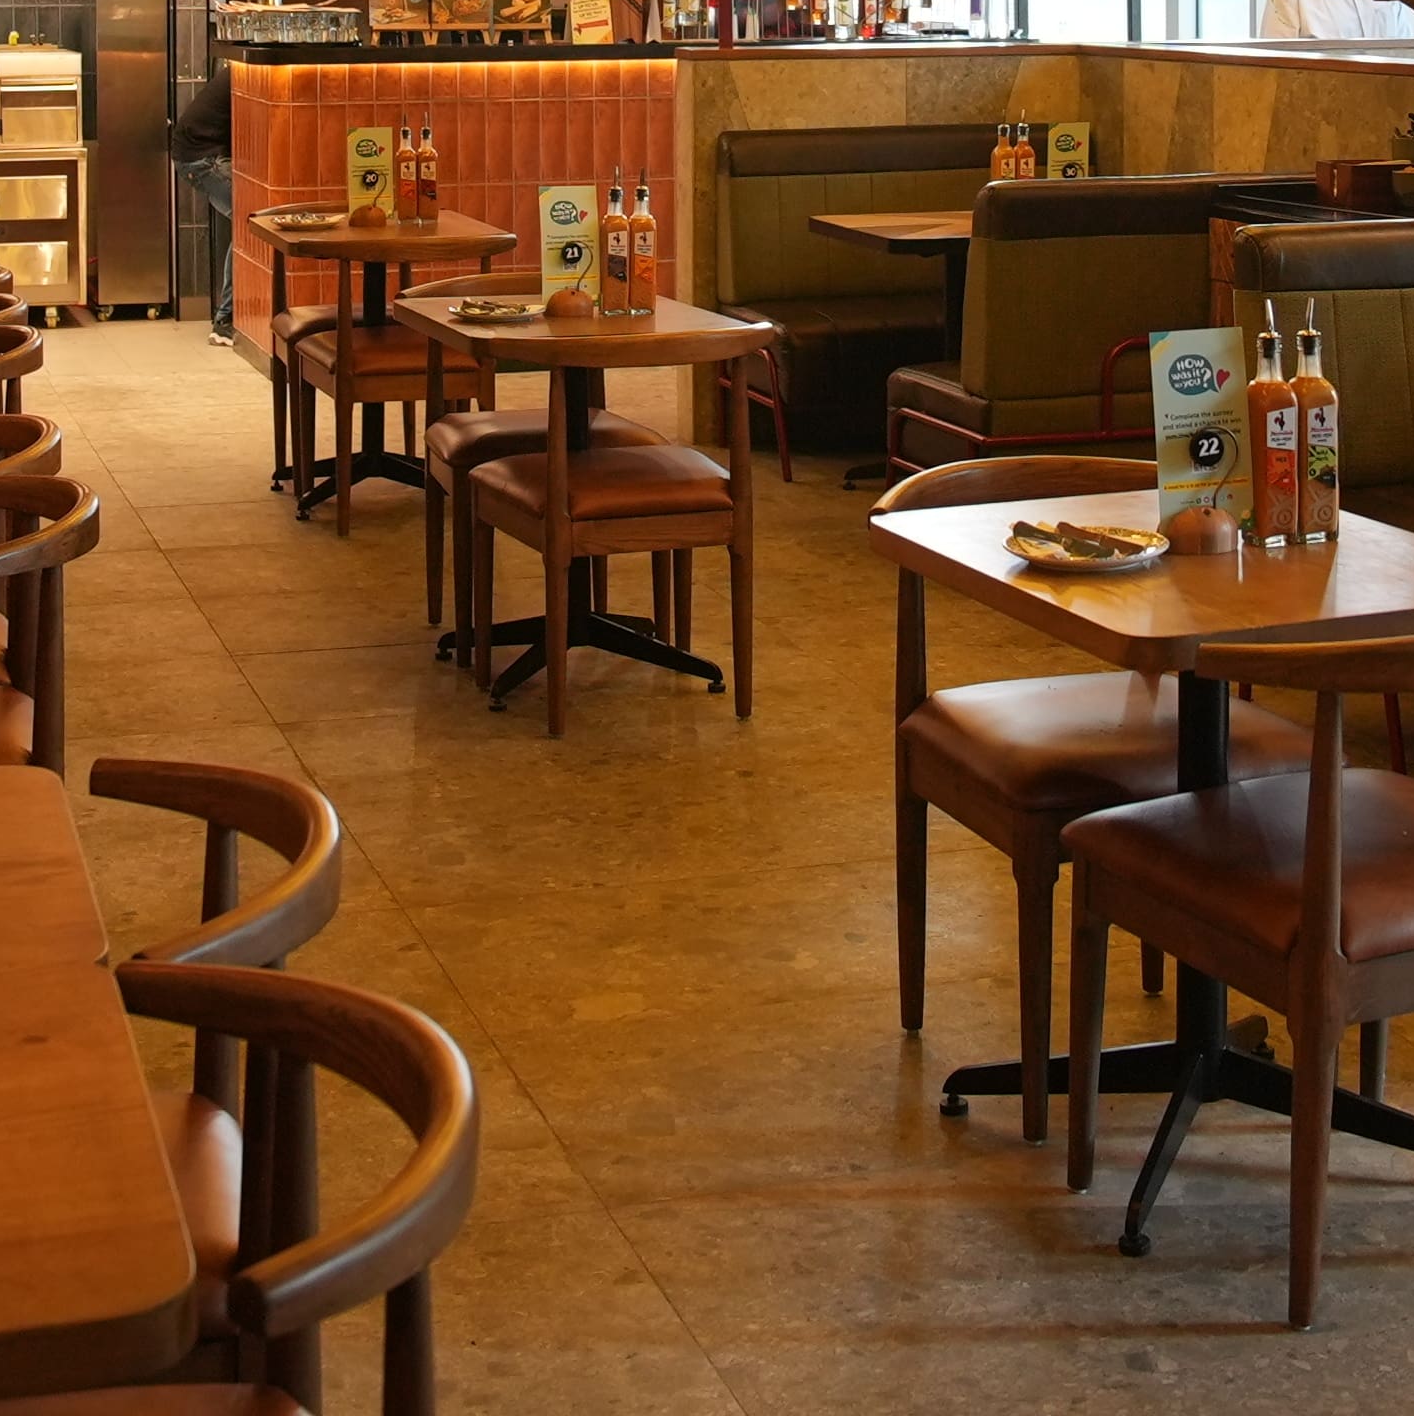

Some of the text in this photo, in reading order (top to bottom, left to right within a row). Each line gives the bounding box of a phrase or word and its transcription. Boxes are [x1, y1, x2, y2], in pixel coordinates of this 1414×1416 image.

[365, 174, 377, 183] 20
[566, 246, 580, 259] 21
[1198, 437, 1220, 457] 22
